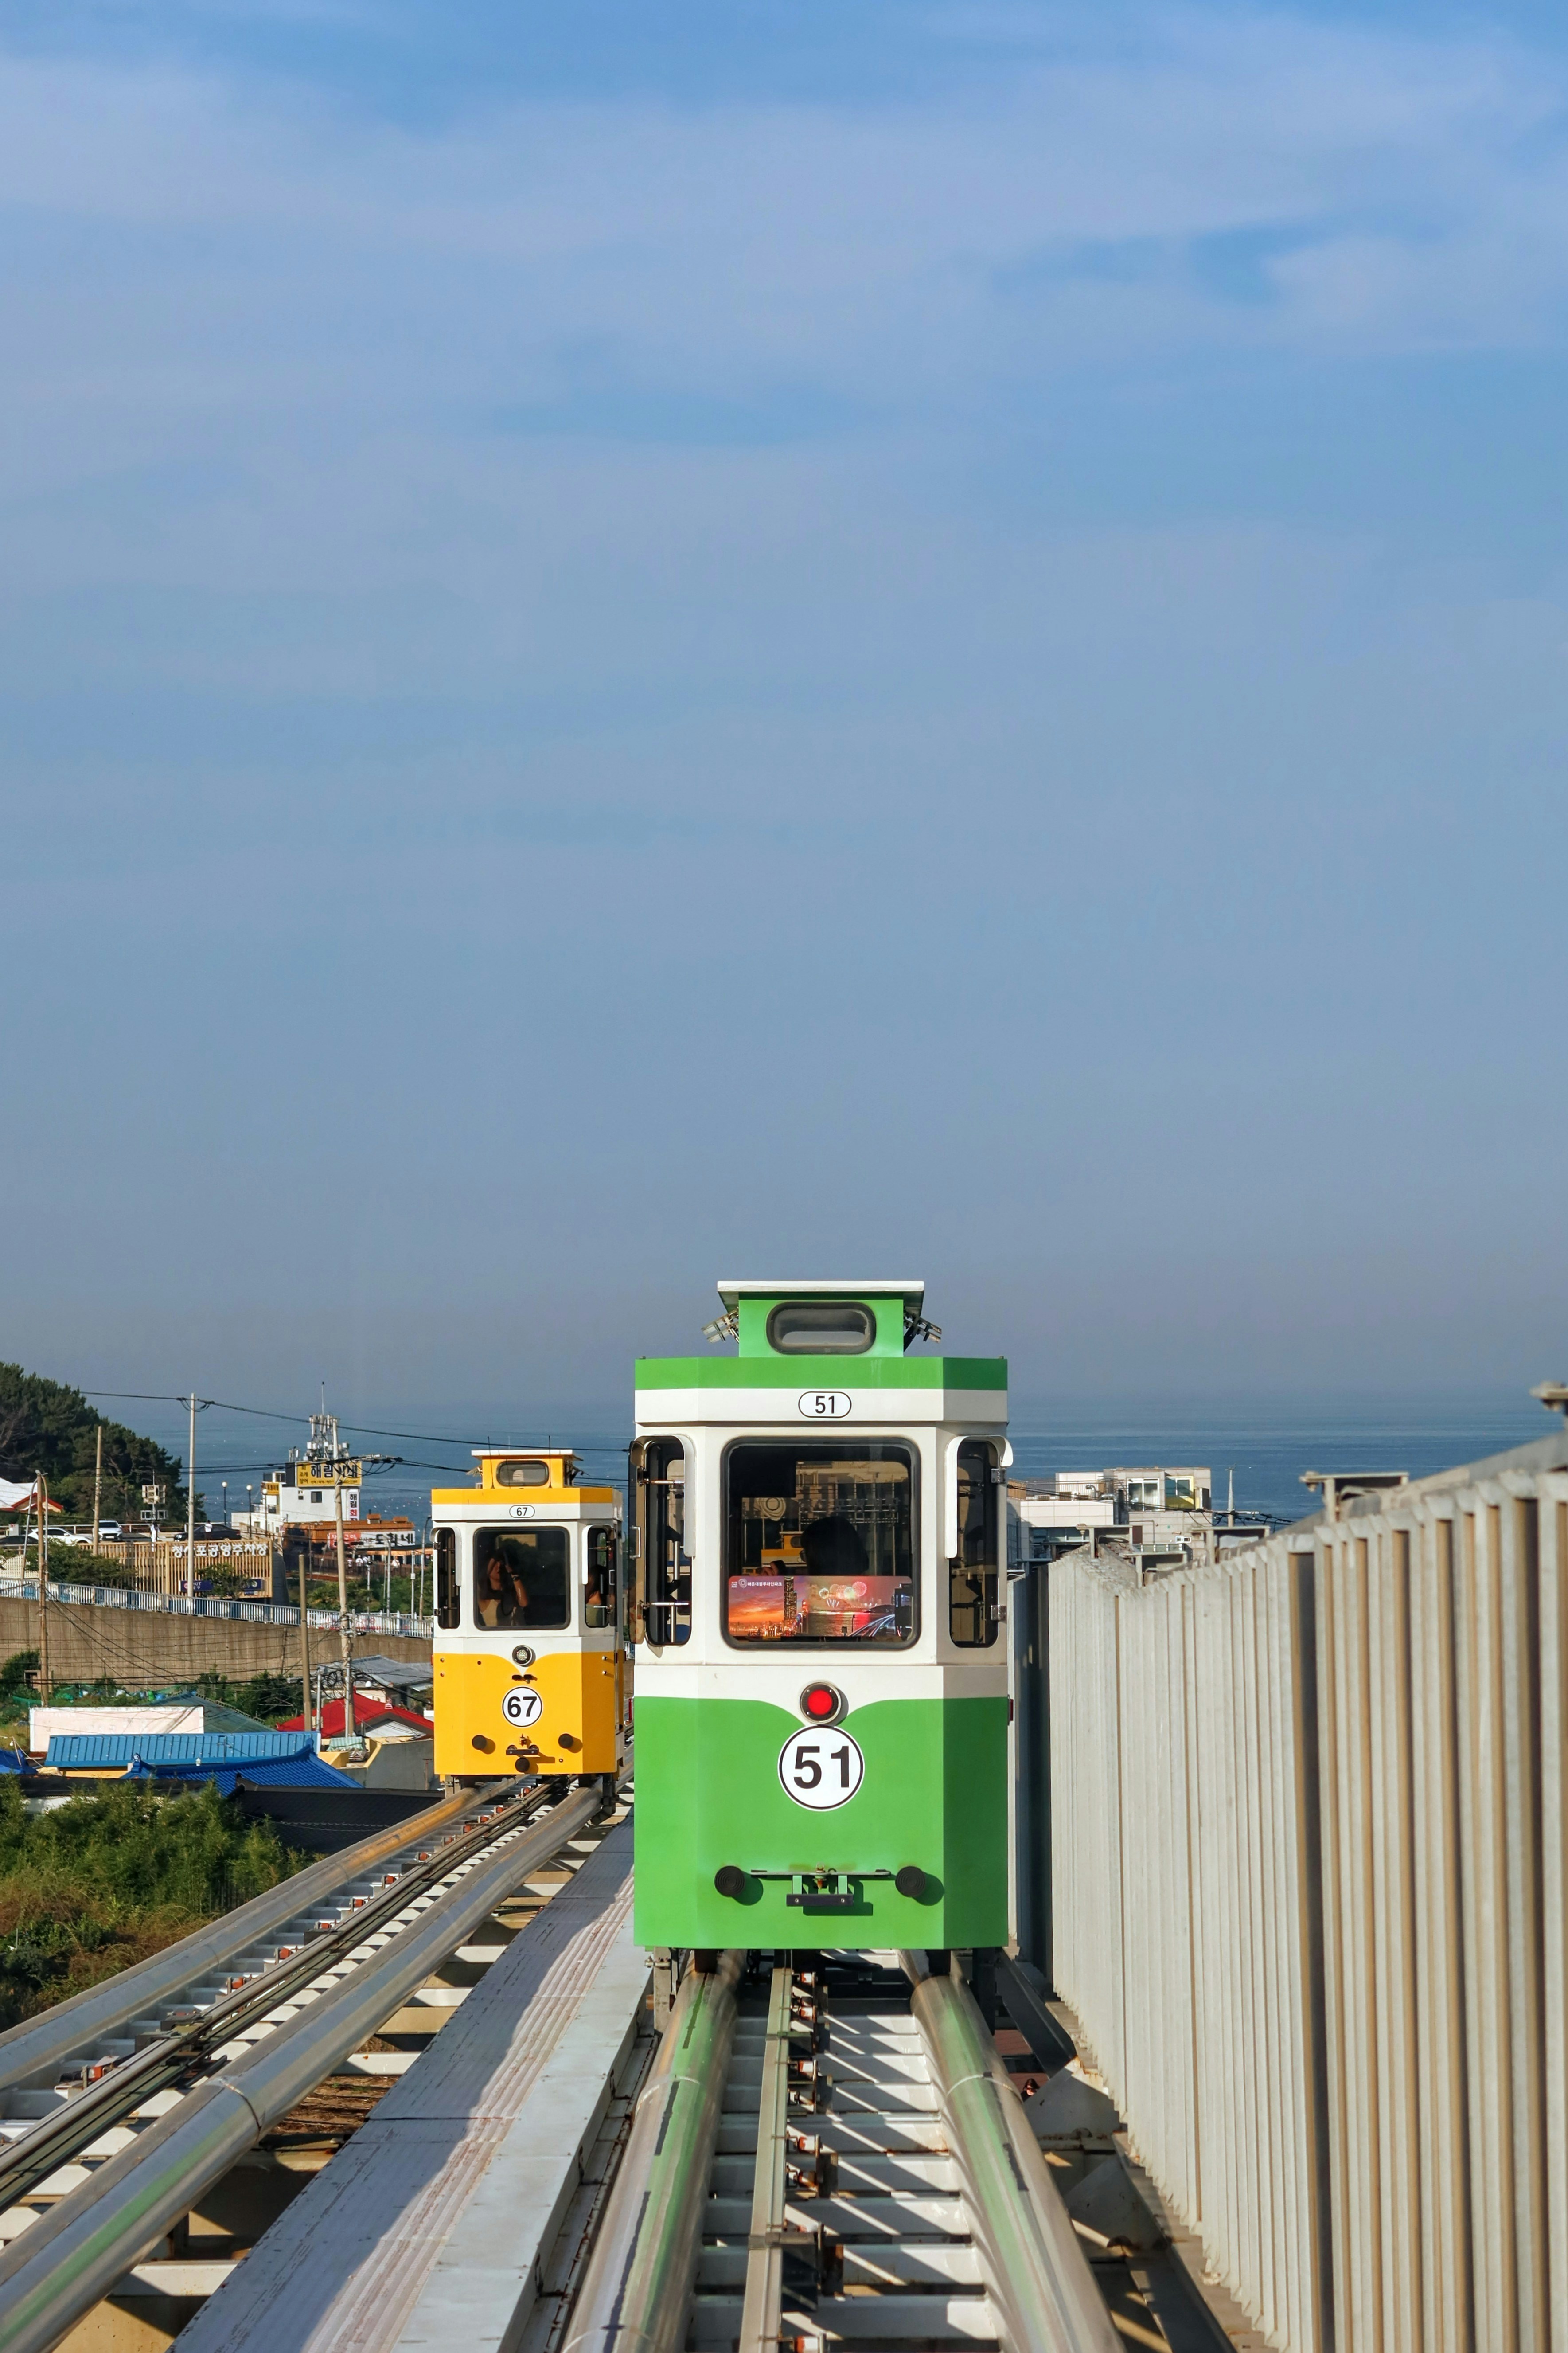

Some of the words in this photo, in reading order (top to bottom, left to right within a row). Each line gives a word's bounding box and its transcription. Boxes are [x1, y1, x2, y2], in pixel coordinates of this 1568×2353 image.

[815, 1396, 835, 1414] 51
[517, 1507, 528, 1517] 67
[507, 1697, 537, 1718] 67
[793, 1746, 850, 1789] 51
